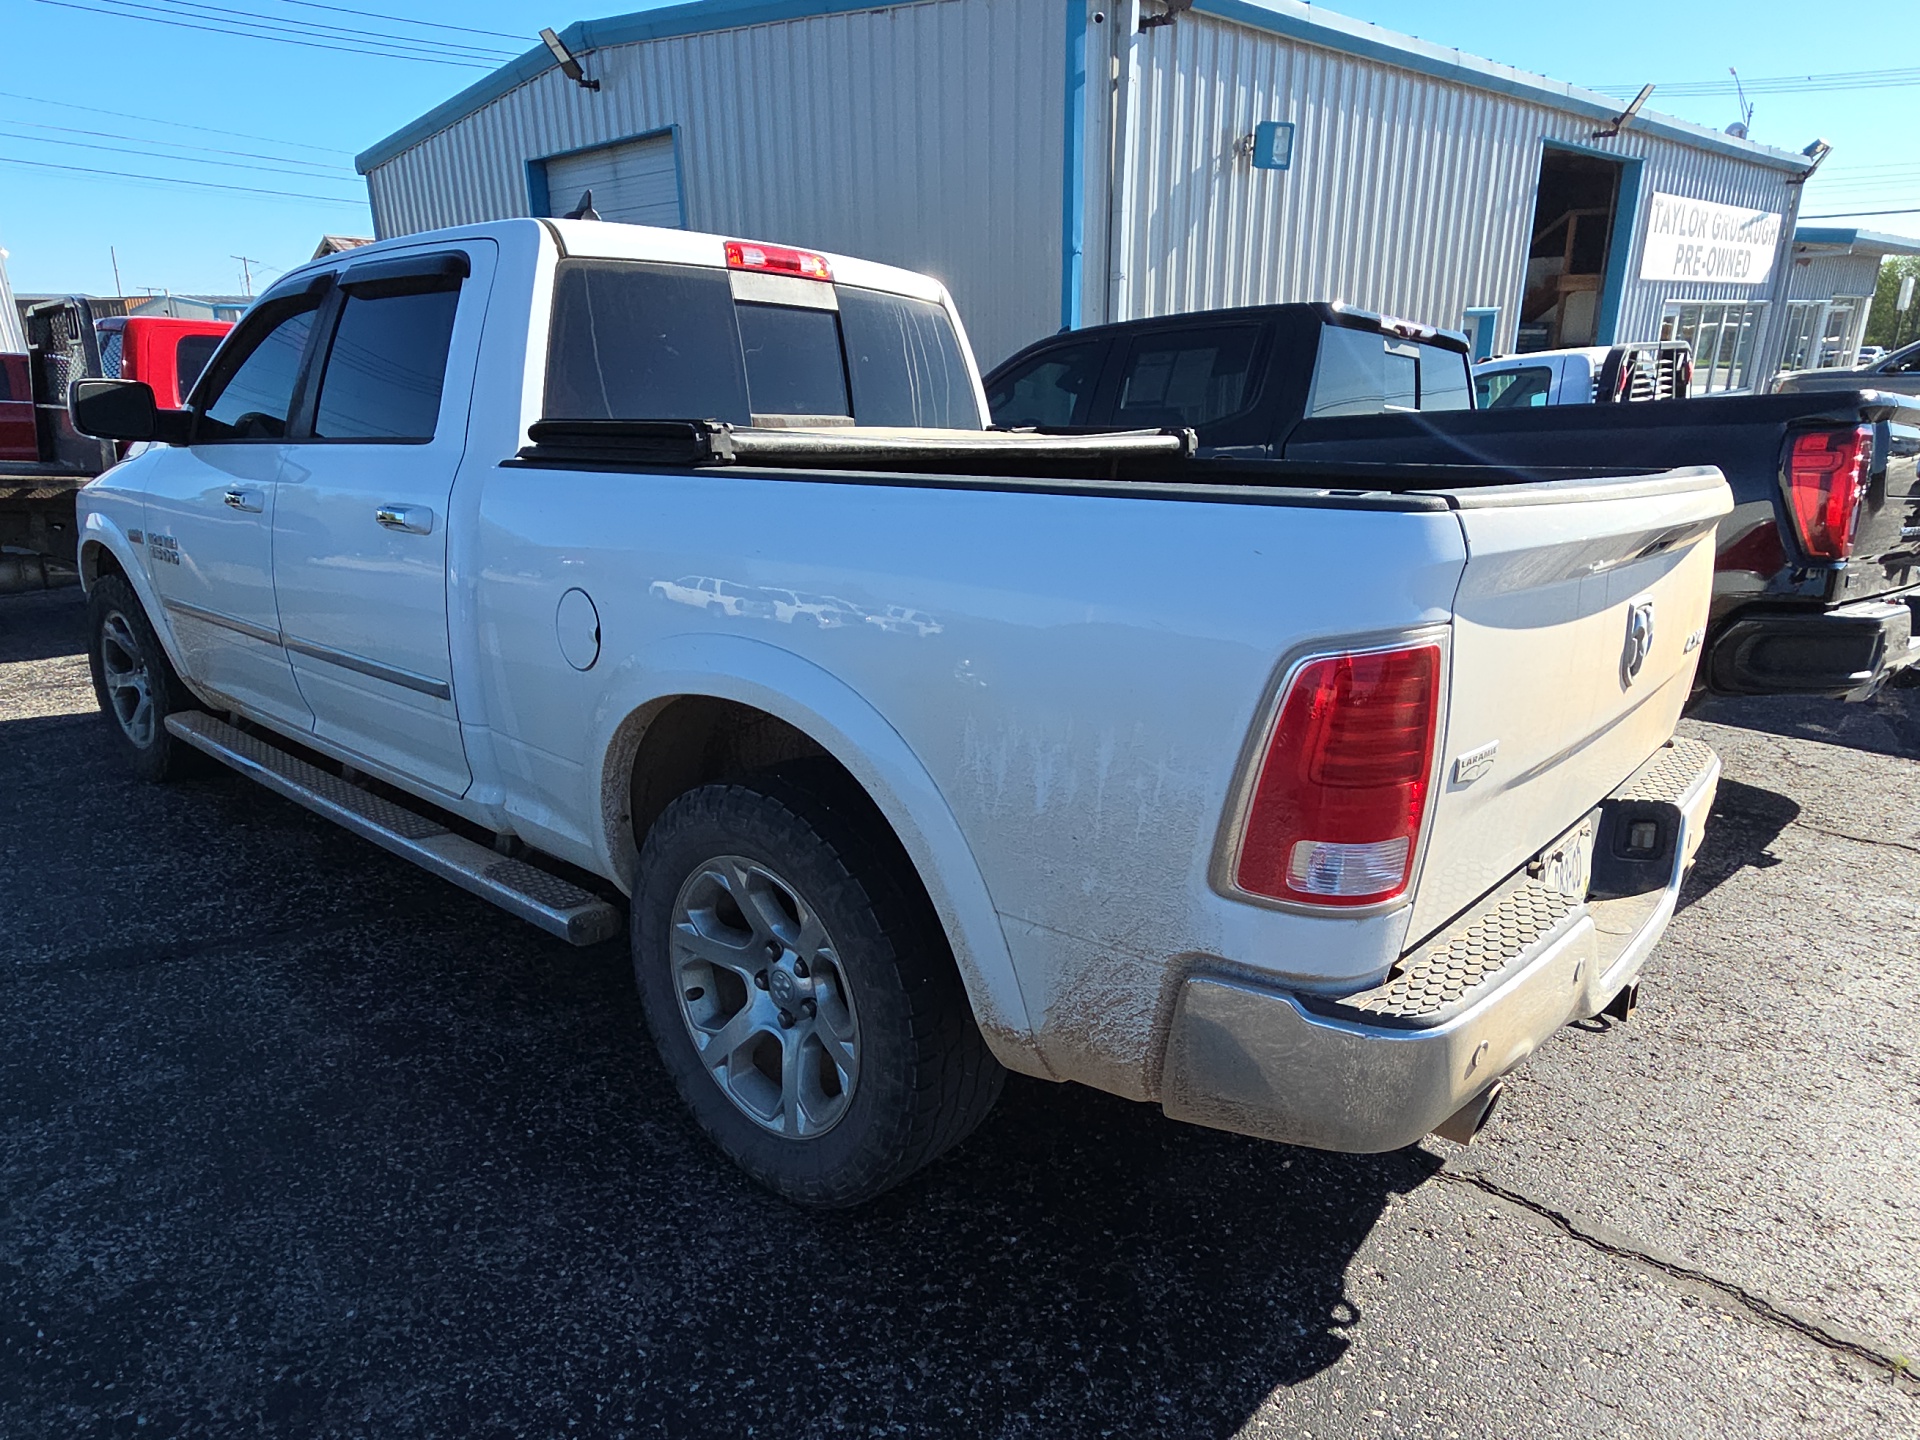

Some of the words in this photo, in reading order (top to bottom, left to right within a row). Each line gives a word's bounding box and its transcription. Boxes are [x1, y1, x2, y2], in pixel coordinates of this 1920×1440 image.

[1653, 200, 1708, 239] TAYLOR
[1711, 211, 1777, 246] GRUBAUGH
[1673, 243, 1752, 278] PRE-OWNED
[1461, 747, 1497, 768] LARAMIE
